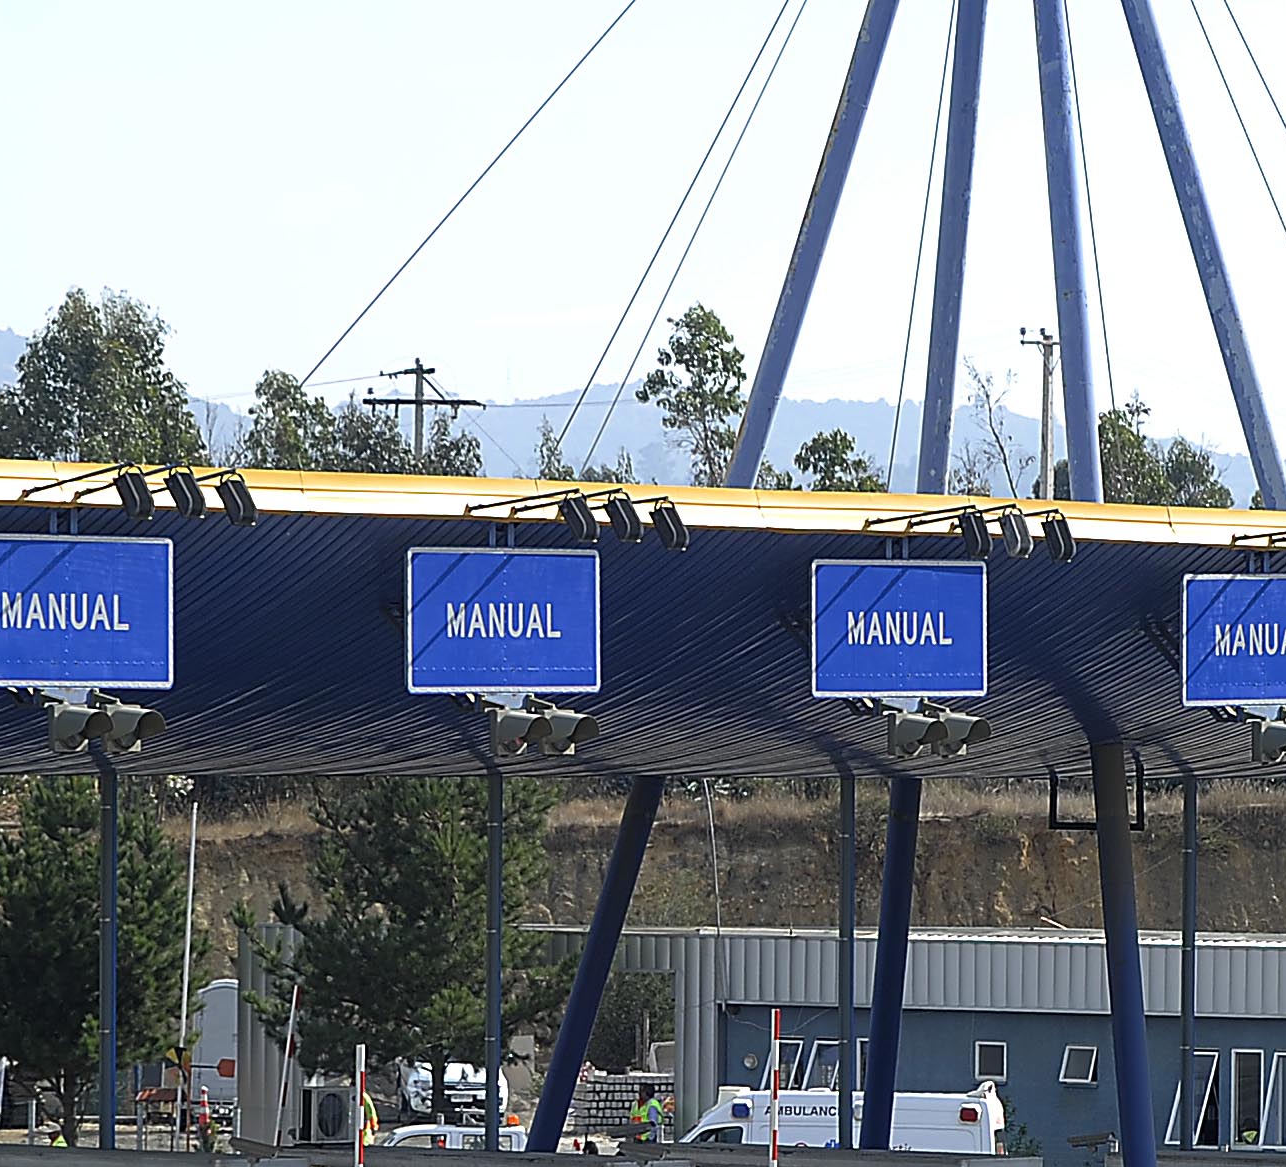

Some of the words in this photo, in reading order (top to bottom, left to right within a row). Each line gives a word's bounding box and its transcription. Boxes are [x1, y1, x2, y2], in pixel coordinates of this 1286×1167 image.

[2, 591, 130, 631] MANUAL
[447, 602, 561, 638] MANUAL
[847, 611, 953, 646] MANUAL
[764, 1105, 839, 1117] AMBULANC
